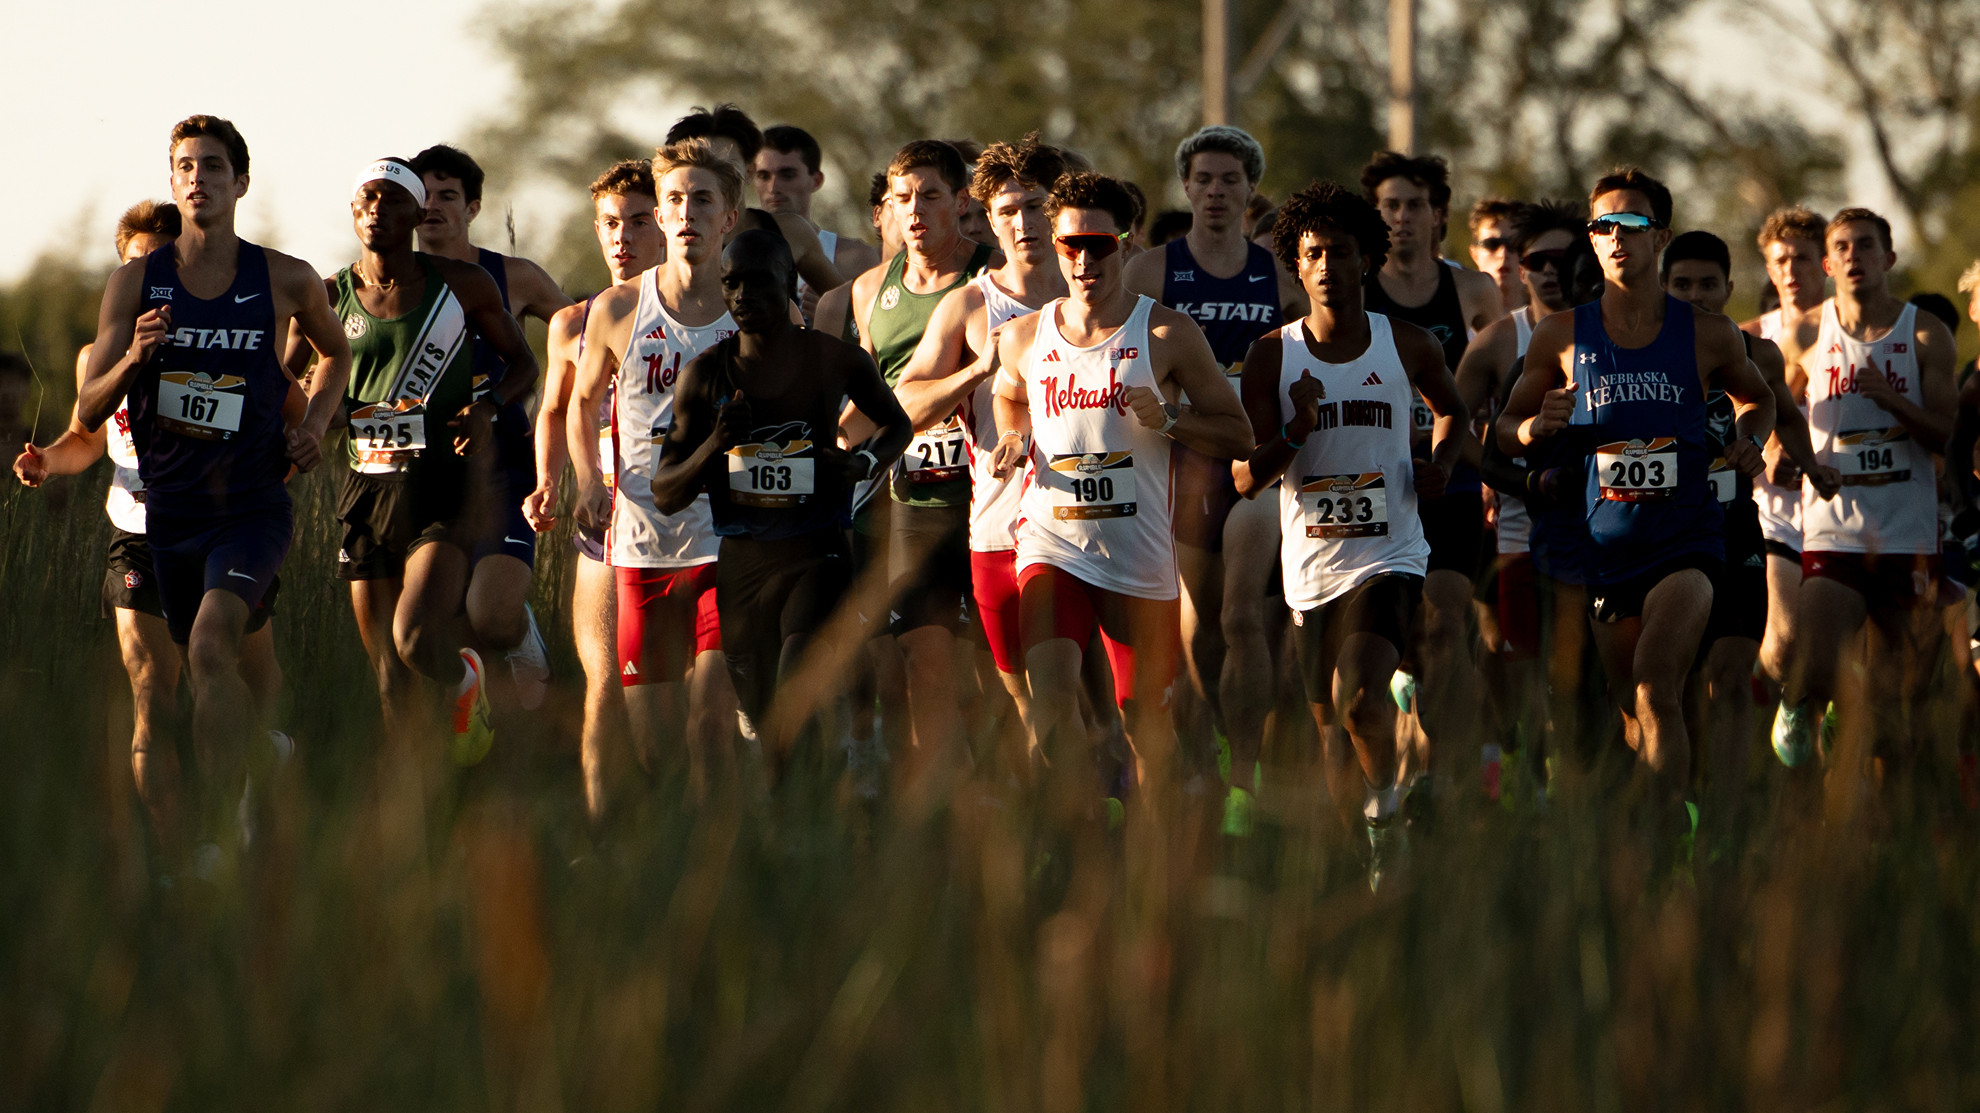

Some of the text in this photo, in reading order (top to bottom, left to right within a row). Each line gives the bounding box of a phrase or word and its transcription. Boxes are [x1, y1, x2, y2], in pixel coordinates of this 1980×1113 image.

[1175, 302, 1274, 323] K-STATE
[162, 327, 265, 350] -STATE
[402, 342, 446, 400] CATS
[1600, 372, 1668, 387] NEBRASKA
[180, 393, 219, 423] 167
[1585, 382, 1684, 412] KEARNEY
[1342, 400, 1392, 429] DAKOTA
[363, 423, 413, 448] 225
[917, 439, 964, 468] 217
[1857, 448, 1893, 471] 194
[748, 465, 792, 491] 163
[1610, 461, 1665, 487] 203
[1070, 477, 1113, 502] 190
[1317, 497, 1373, 524] 233
